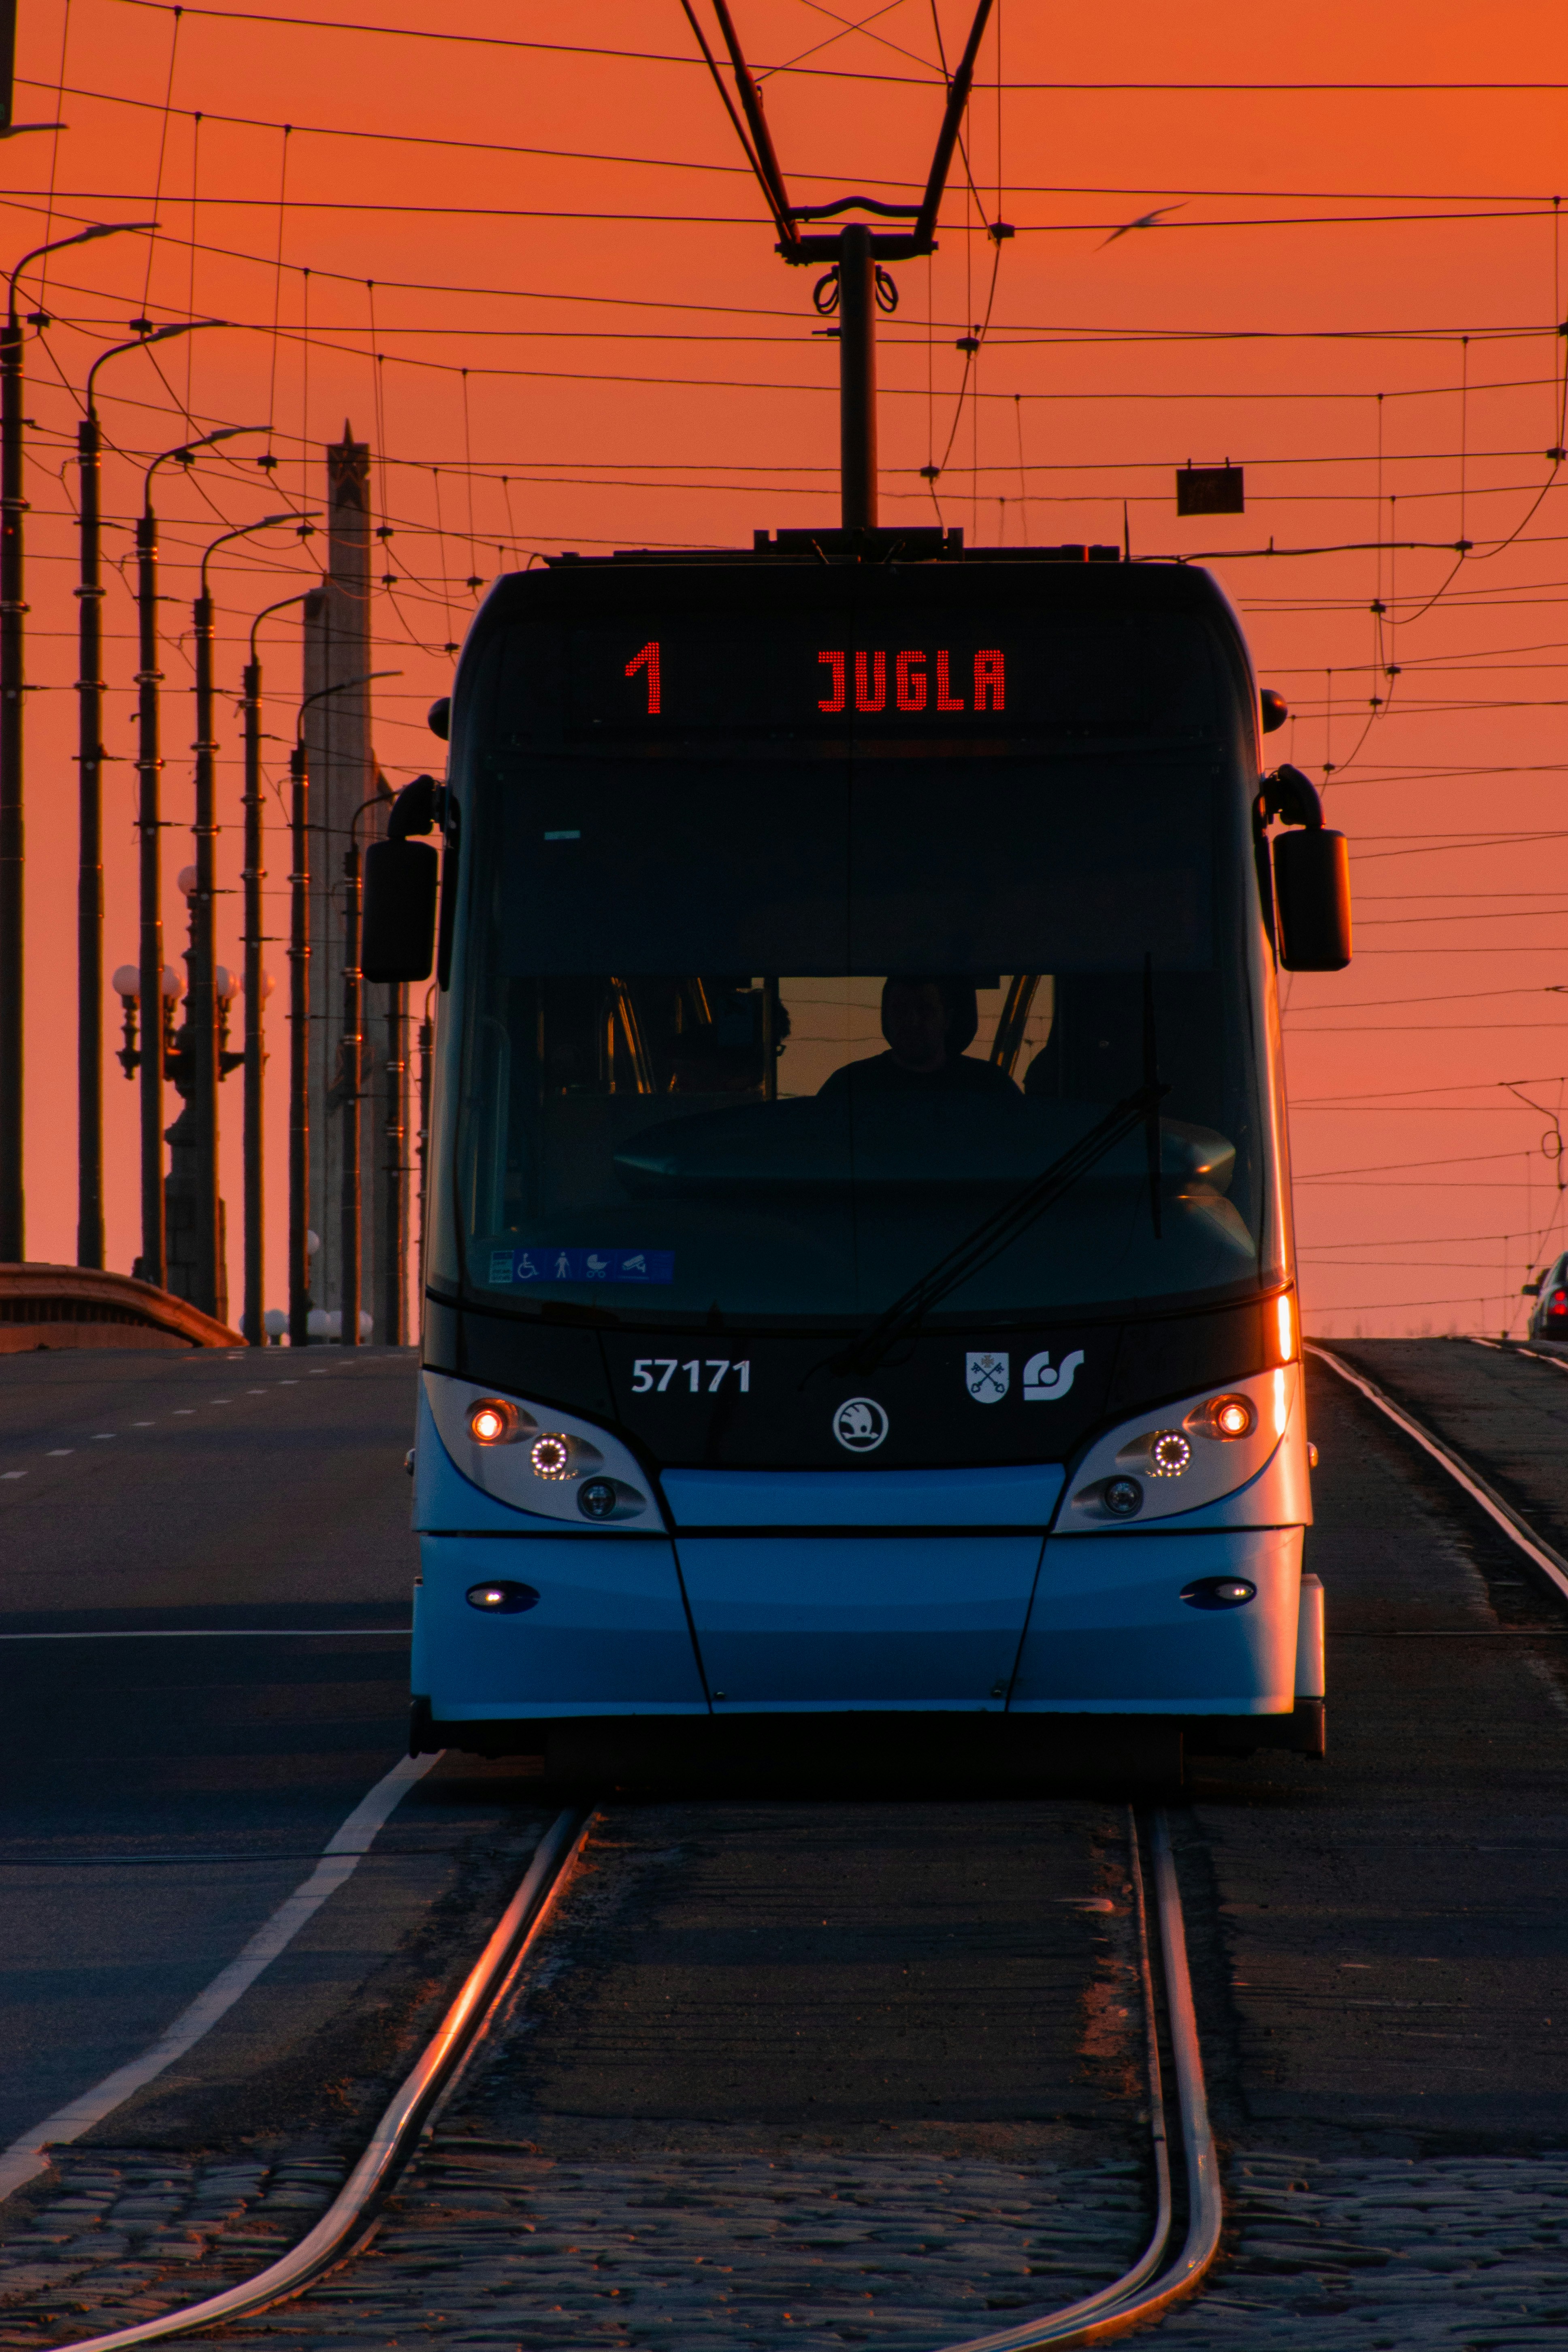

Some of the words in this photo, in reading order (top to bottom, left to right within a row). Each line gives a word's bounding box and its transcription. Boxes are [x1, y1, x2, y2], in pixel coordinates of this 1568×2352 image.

[625, 642, 660, 714] 1
[818, 650, 1005, 712] JUGLA
[631, 1359, 750, 1393] 57171
